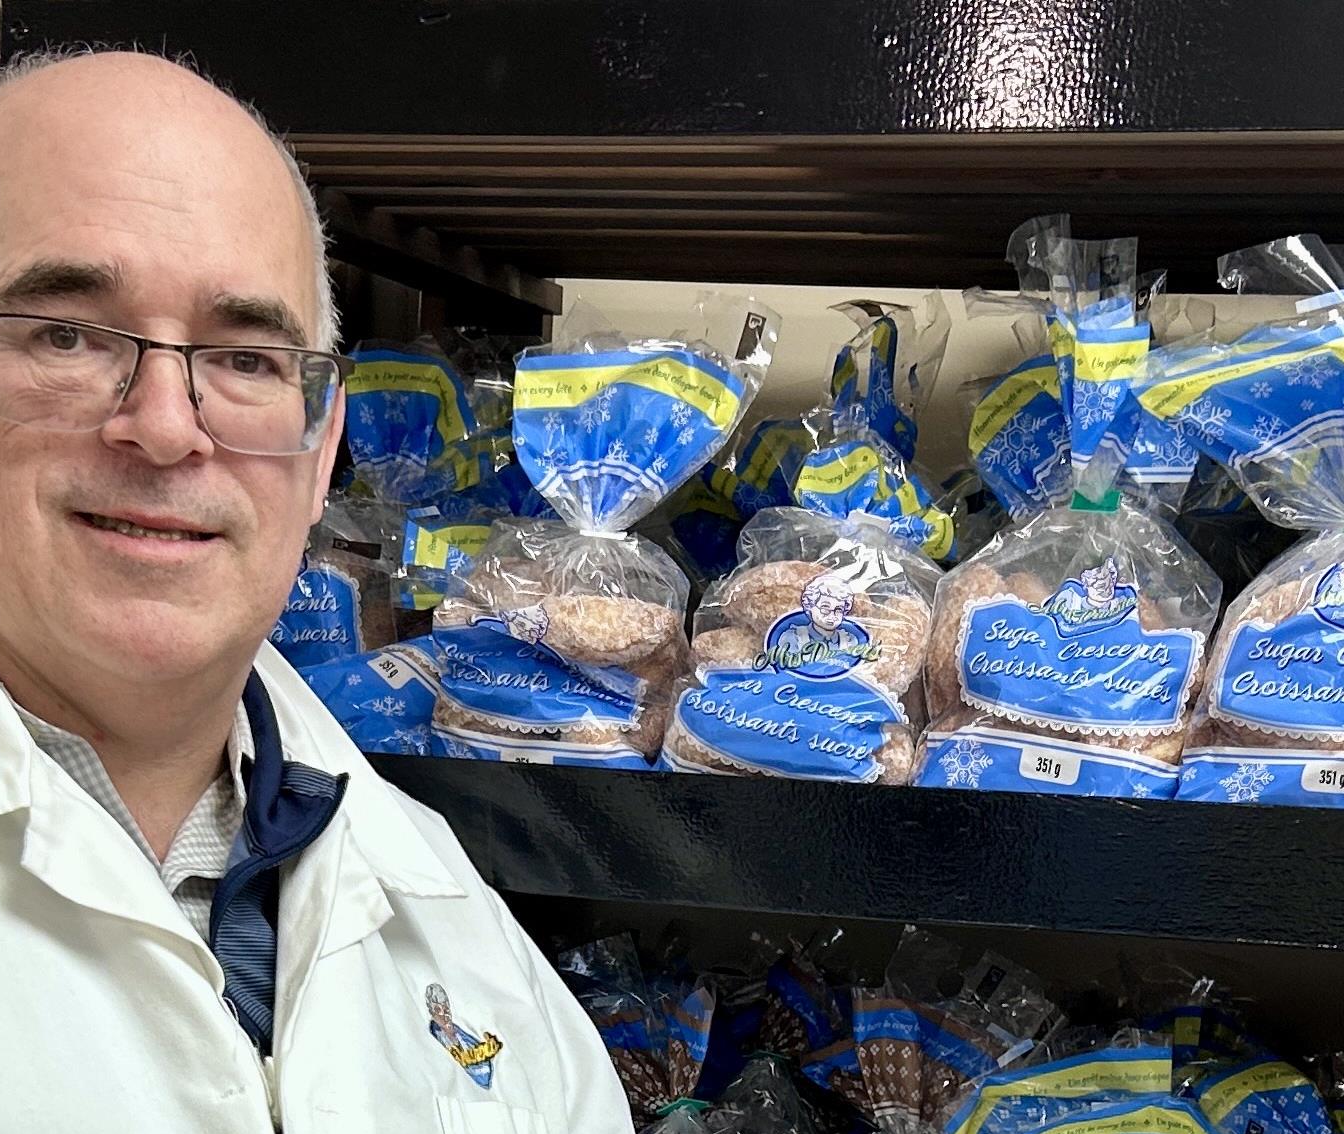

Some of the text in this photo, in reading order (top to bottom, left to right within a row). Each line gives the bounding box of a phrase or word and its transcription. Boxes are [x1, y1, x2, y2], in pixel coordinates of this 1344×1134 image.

[984, 619, 1171, 666] Sugar Crescents
[1247, 637, 1324, 668] Sugar
[968, 651, 1090, 689] Croissants
[1035, 756, 1062, 778] 351 g
[1319, 769, 1337, 787] 351
